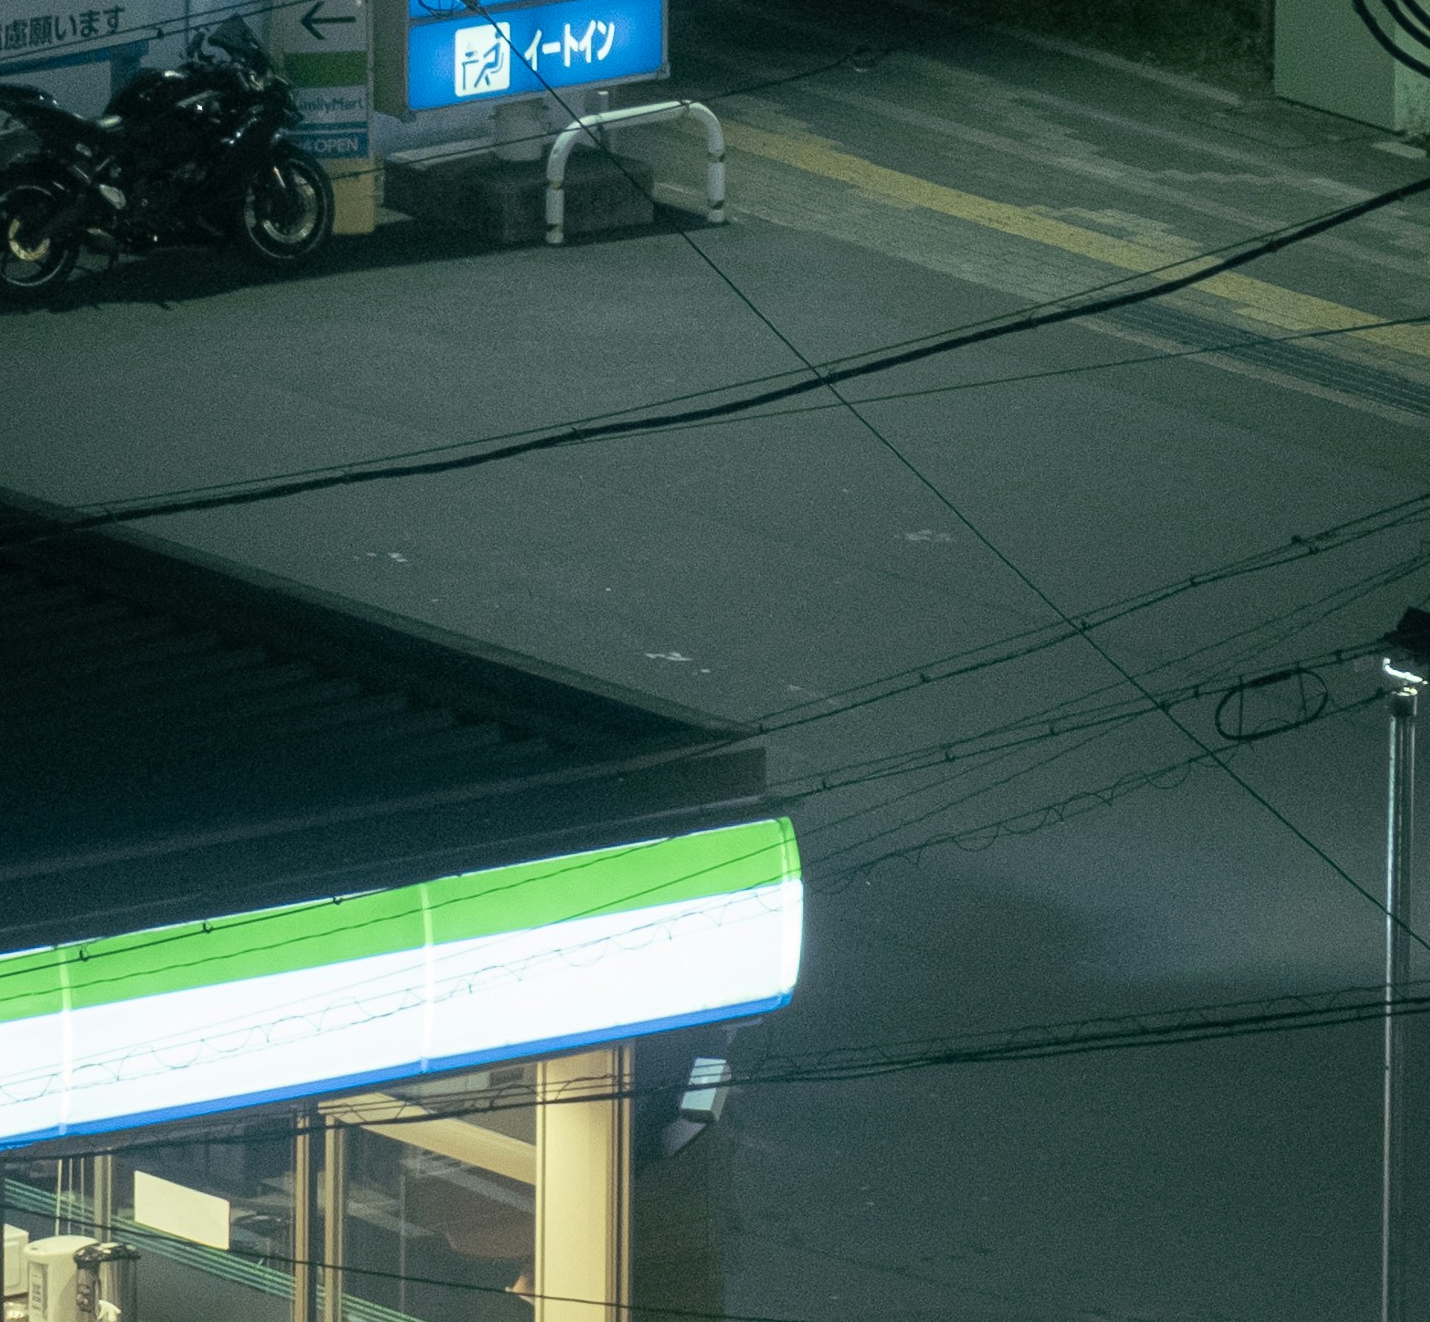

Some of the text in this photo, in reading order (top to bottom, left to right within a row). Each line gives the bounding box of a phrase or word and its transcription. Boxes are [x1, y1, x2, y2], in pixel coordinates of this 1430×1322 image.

[524, 18, 616, 71] イートイン
